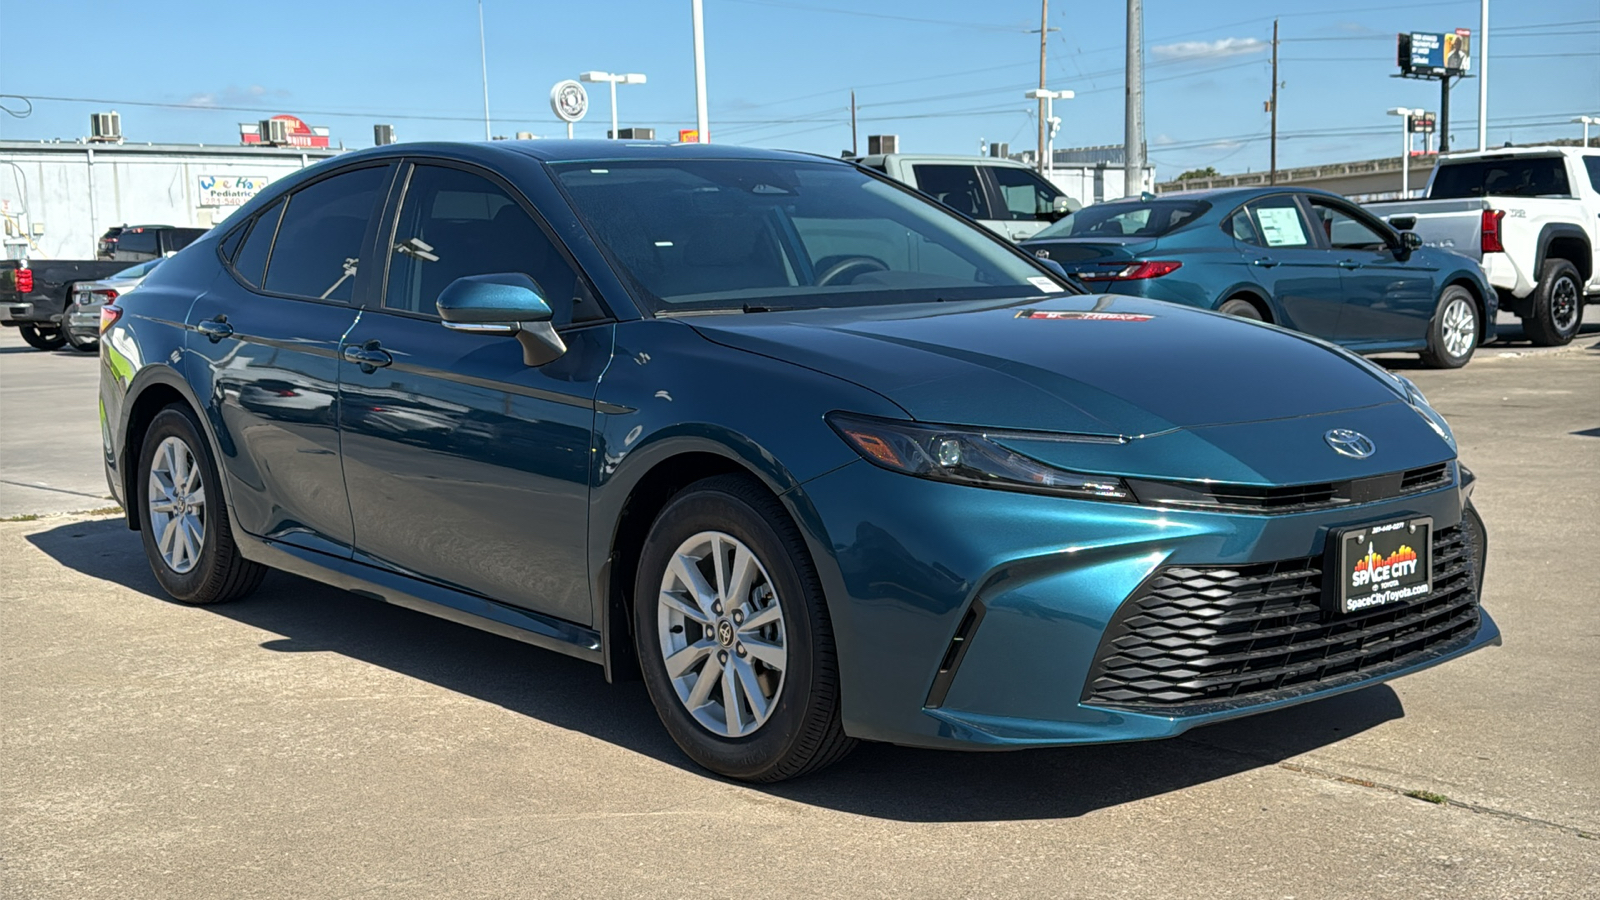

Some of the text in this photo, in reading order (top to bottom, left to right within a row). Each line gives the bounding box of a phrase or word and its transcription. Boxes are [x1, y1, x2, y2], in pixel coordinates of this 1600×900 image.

[1352, 558, 1417, 587] SPACE CITY
[1381, 580, 1399, 589] TOYOTA
[1347, 583, 1429, 611] SpaceCityToyota.com
